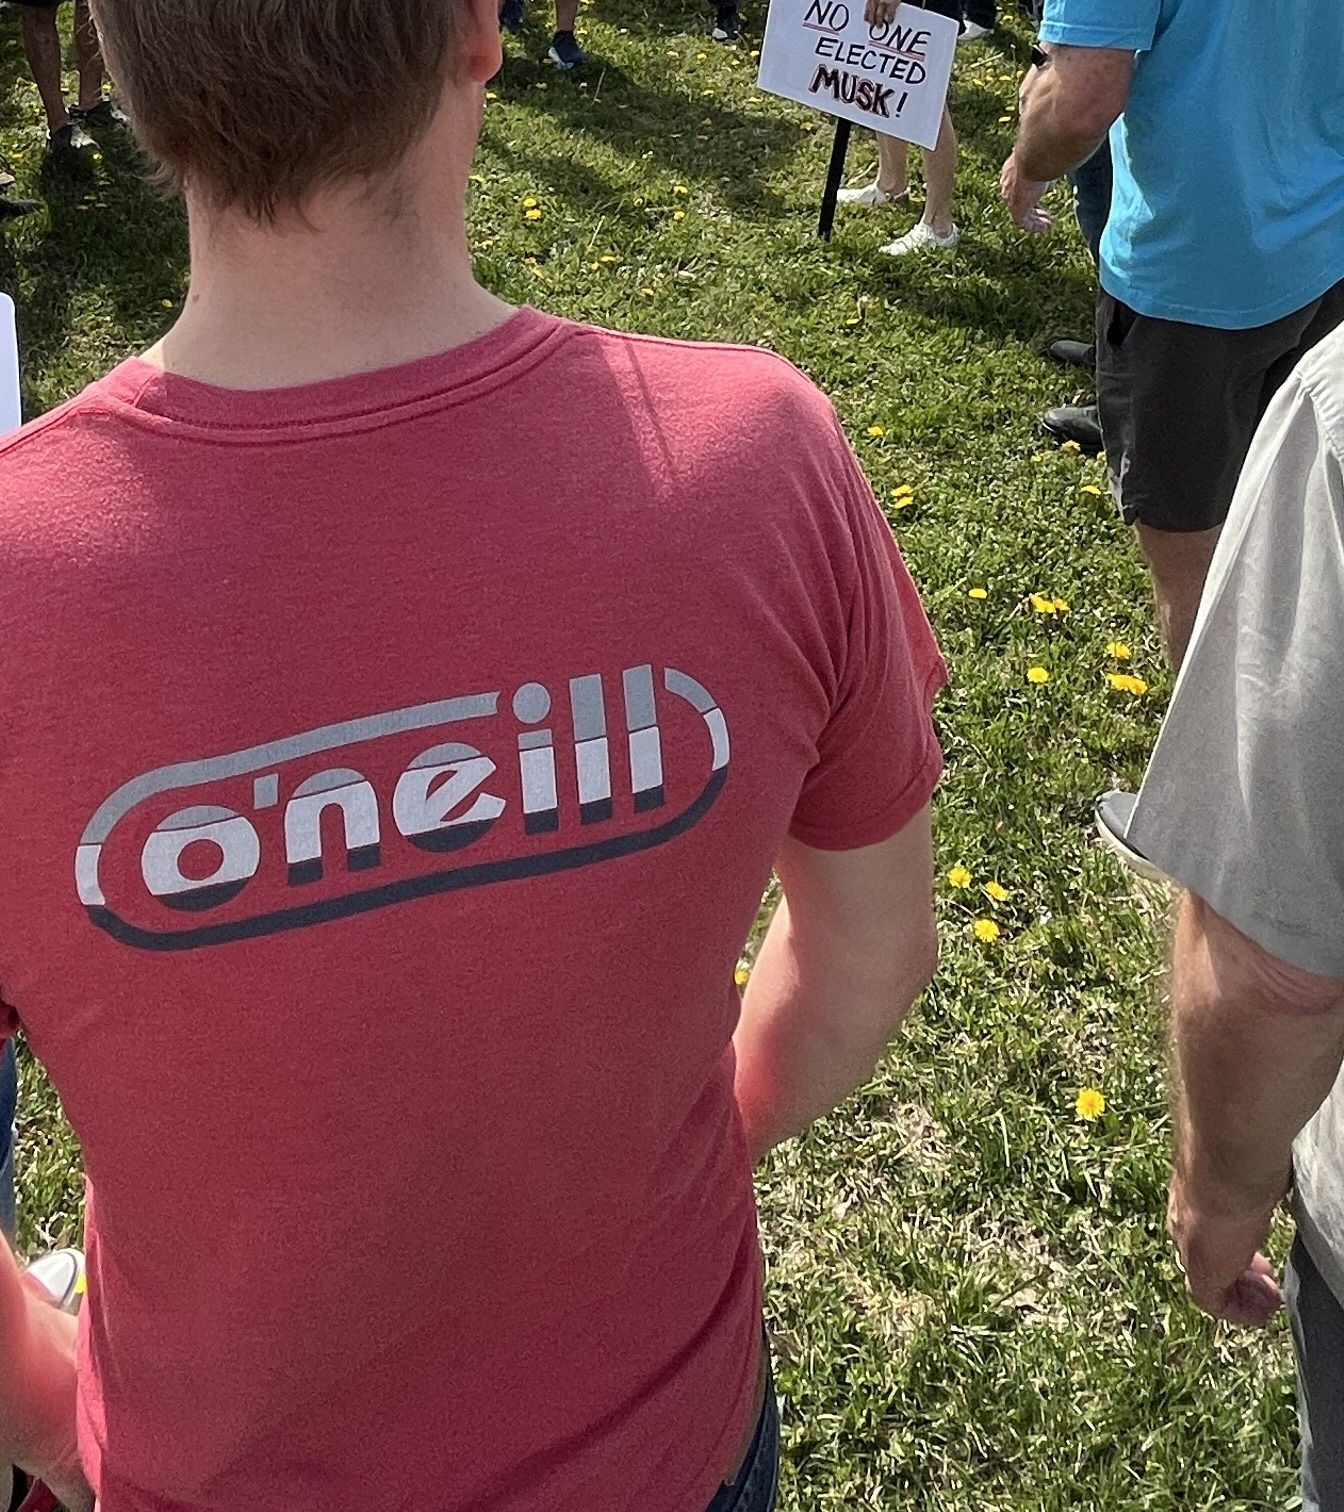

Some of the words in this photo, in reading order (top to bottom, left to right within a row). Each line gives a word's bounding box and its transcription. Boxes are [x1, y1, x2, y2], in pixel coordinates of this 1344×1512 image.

[815, 36, 927, 85] ELECTED
[869, 19, 932, 56] ONE
[807, 63, 909, 119] MUSK!
[141, 663, 666, 912] o'neill
